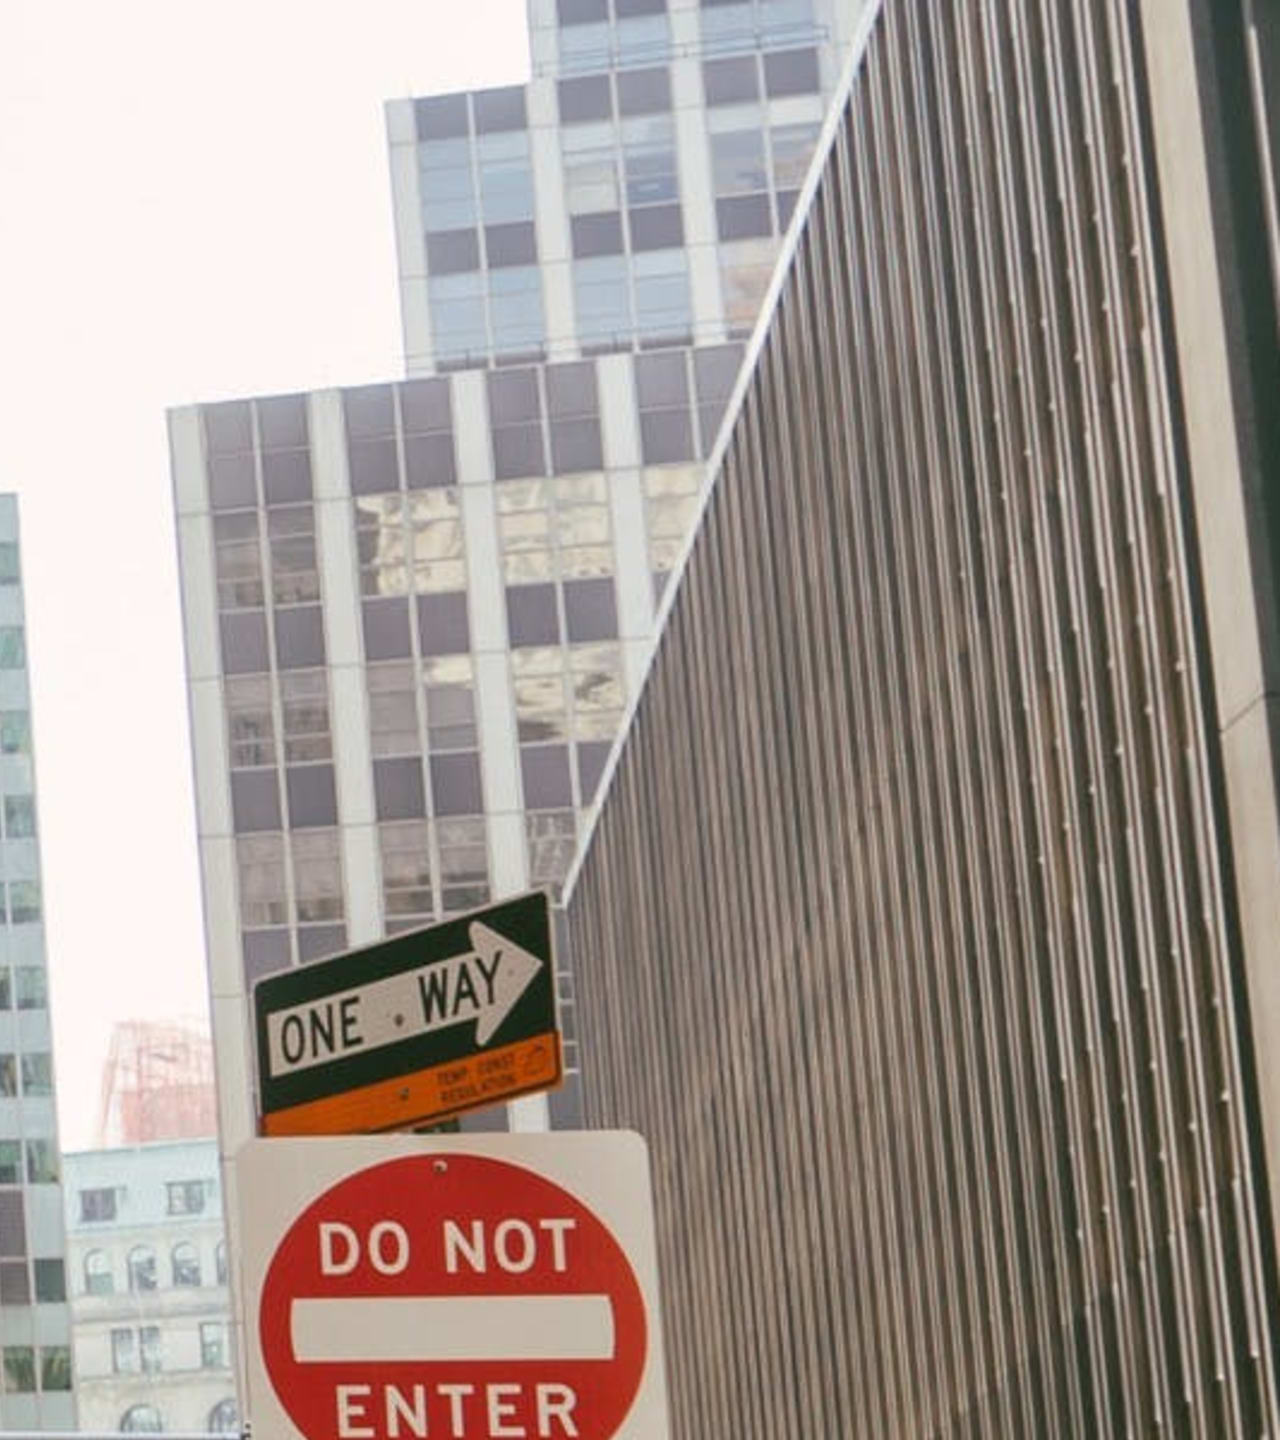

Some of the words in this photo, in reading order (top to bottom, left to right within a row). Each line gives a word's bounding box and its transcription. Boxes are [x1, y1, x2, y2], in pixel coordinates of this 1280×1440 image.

[281, 996, 363, 1065] ONE
[418, 951, 503, 1024] WAY
[319, 1219, 410, 1275] DO
[444, 1218, 577, 1274] NOT
[336, 1383, 579, 1438] ENTER
